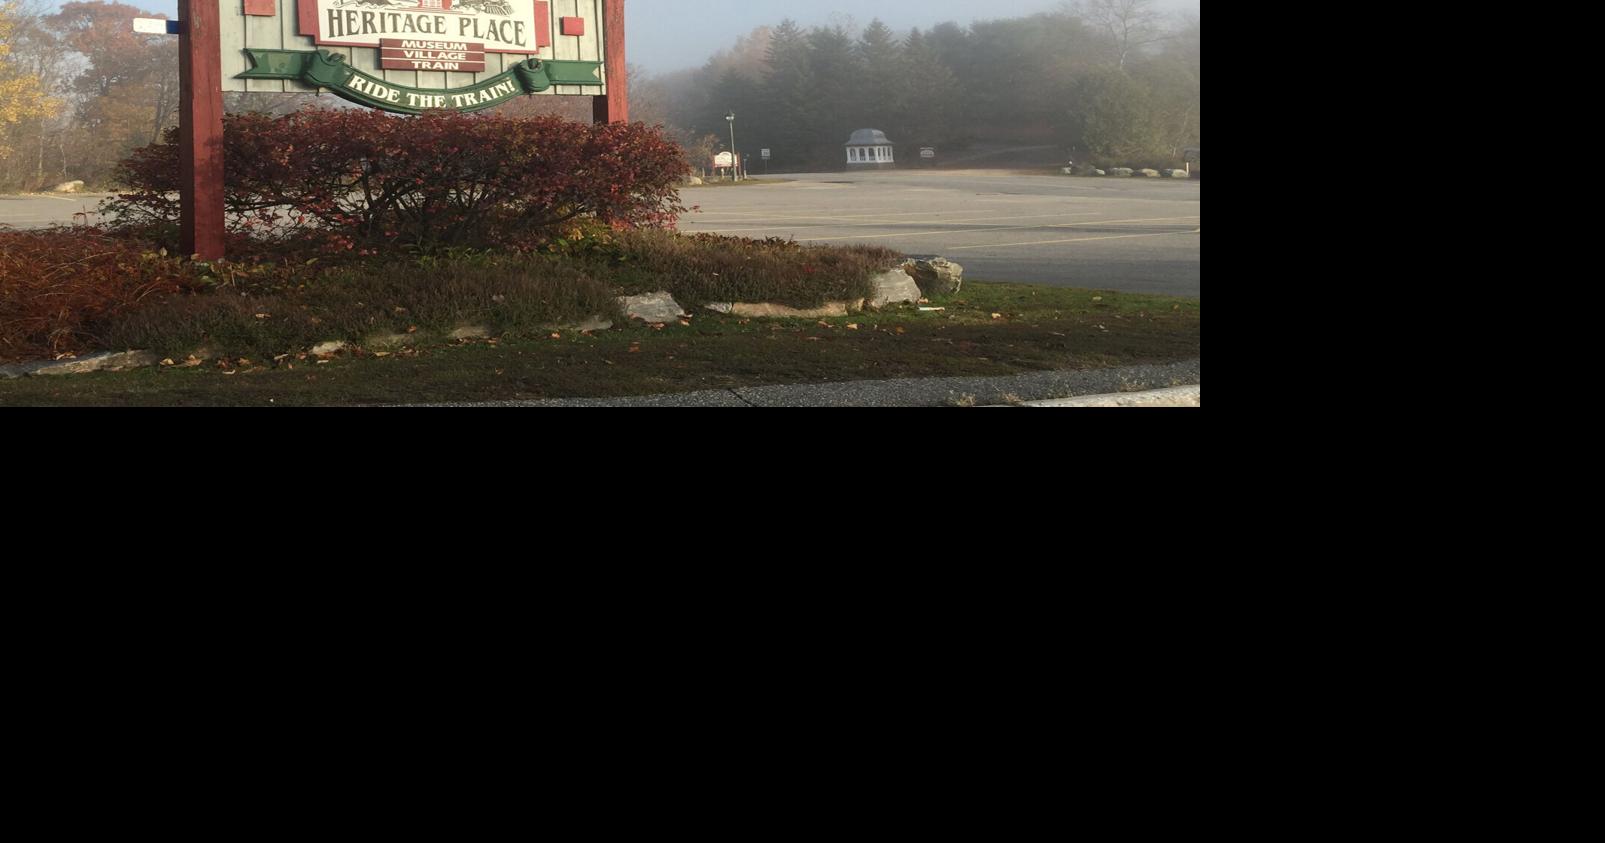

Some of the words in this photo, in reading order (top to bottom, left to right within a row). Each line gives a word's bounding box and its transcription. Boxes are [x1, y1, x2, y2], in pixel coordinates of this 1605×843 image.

[327, 8, 447, 38] HERITAGE
[459, 17, 527, 47] PLACE
[401, 40, 467, 50] MUSEUM
[404, 51, 466, 60] VILLAGE
[412, 61, 459, 70] TRAIN
[348, 75, 400, 103] RIDE
[406, 92, 446, 108] THE
[451, 79, 518, 108] TRAIN!
